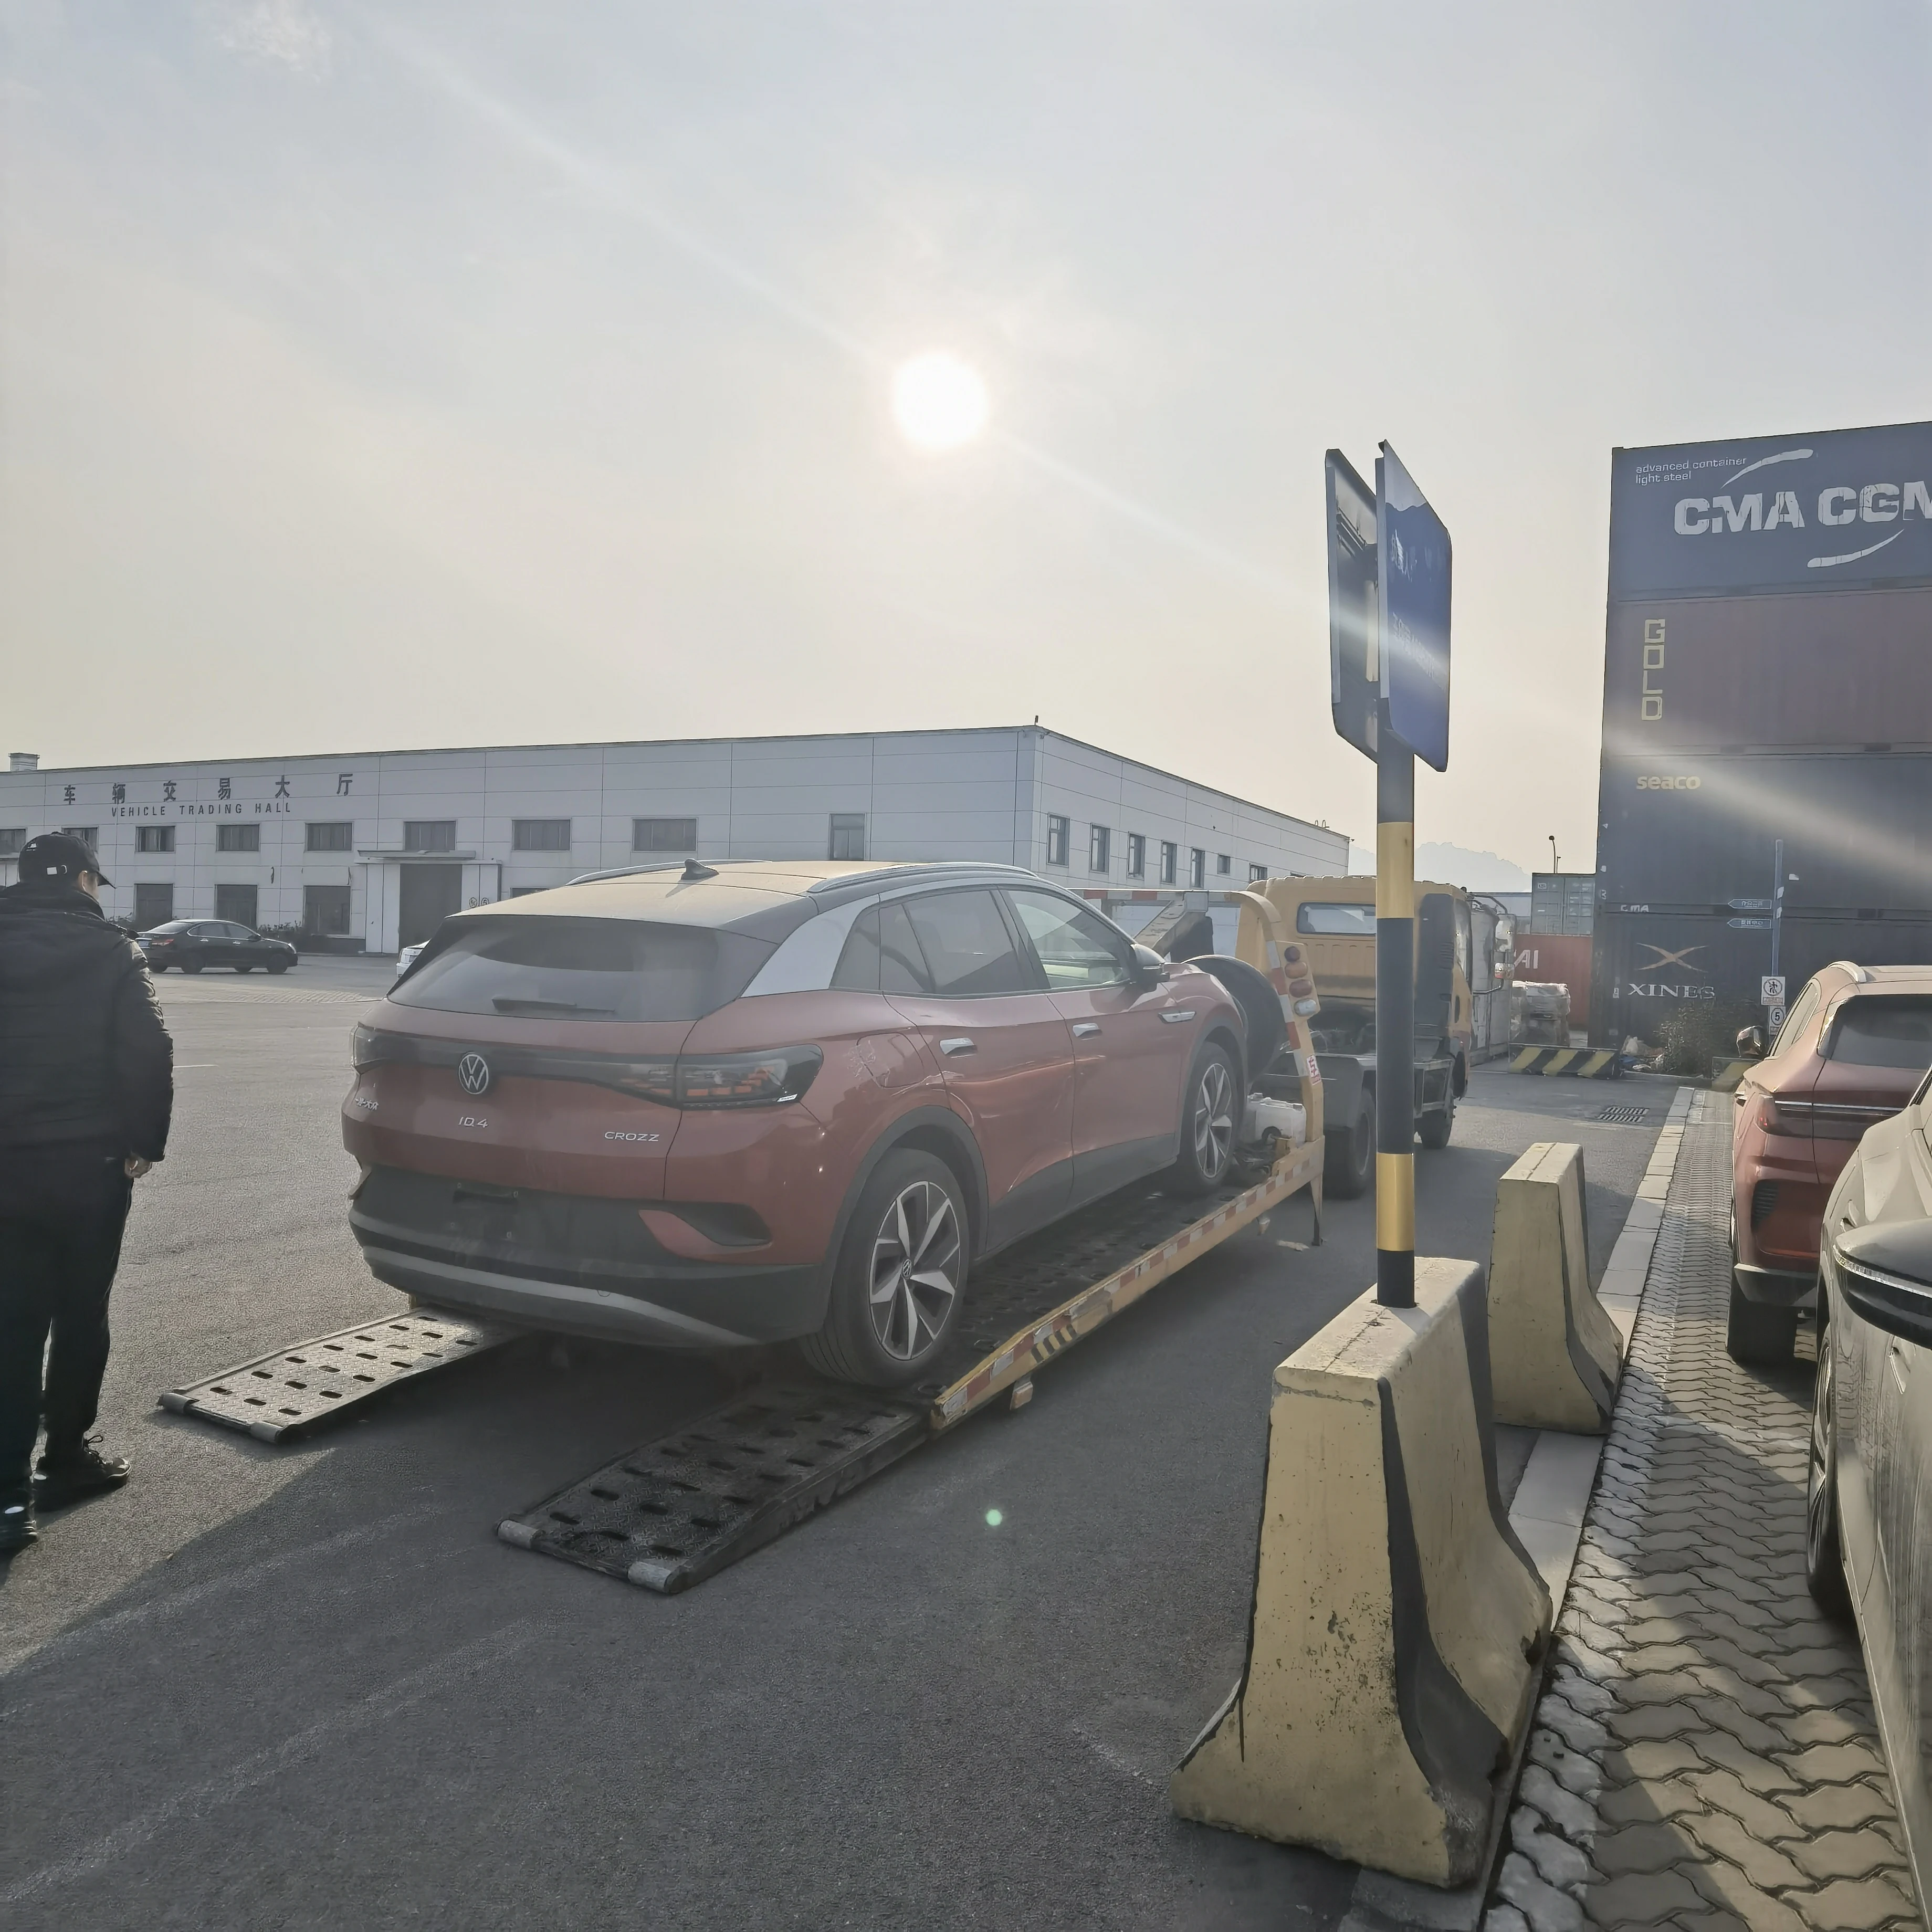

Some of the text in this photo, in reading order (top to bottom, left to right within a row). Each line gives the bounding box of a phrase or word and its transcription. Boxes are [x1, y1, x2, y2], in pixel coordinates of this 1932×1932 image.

[1636, 457, 1747, 473] advanced container
[1636, 470, 1691, 486] light steel
[1674, 491, 1805, 535] CMA
[1641, 618, 1665, 720] GOLD
[64, 773, 353, 805] 车辆交易大厅
[1636, 776, 1701, 790] seaco
[111, 802, 291, 817] VEHICLE TRADING HALL
[1513, 949, 1538, 969] AI
[1774, 1012, 1780, 1021] 5
[604, 1131, 660, 1142] CROZZ
